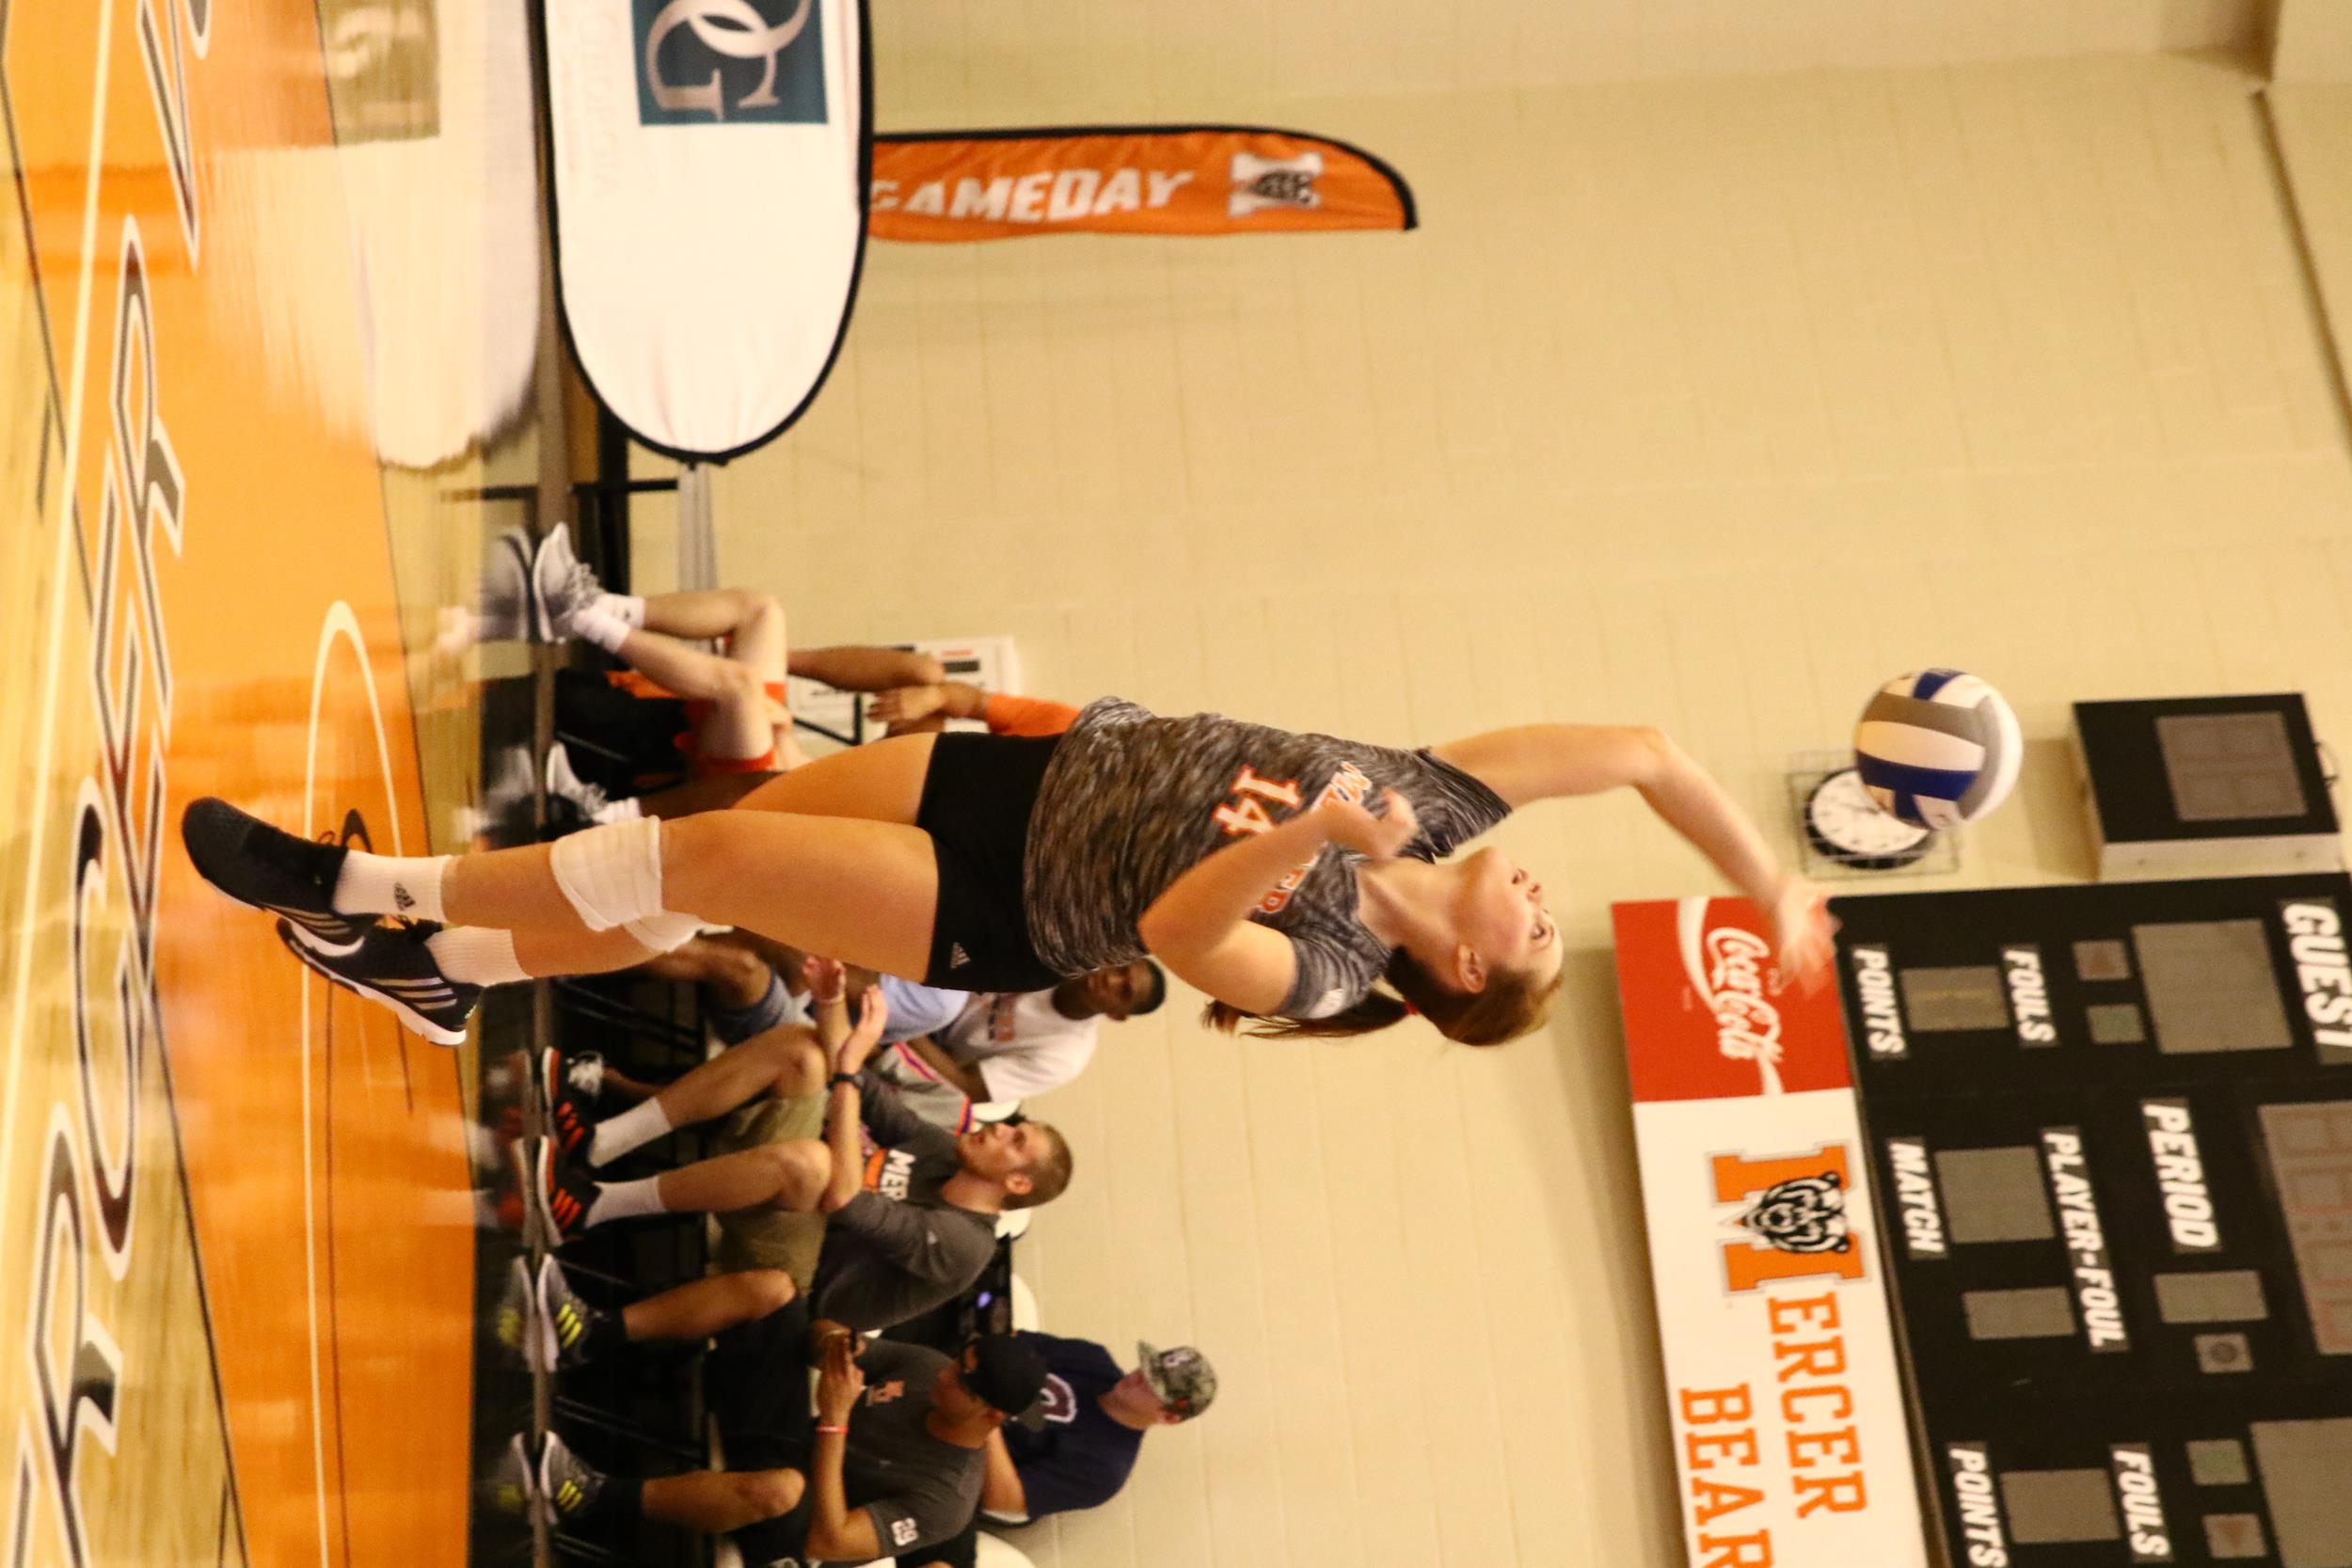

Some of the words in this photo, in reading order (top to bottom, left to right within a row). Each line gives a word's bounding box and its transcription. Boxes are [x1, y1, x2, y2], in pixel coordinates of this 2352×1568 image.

[1212, 764, 1304, 835] 14
[1854, 948, 1904, 1053] POINTS
[2005, 950, 2055, 1042] FOULS
[2282, 904, 2352, 1048] GUEST
[1890, 1143, 1945, 1252] MATCH
[2143, 1104, 2217, 1247] PERIOD
[2044, 1132, 2124, 1347] PLAYER-FOUL
[1950, 1449, 2007, 1568] POINTS
[2114, 1449, 2169, 1556] FOULS
